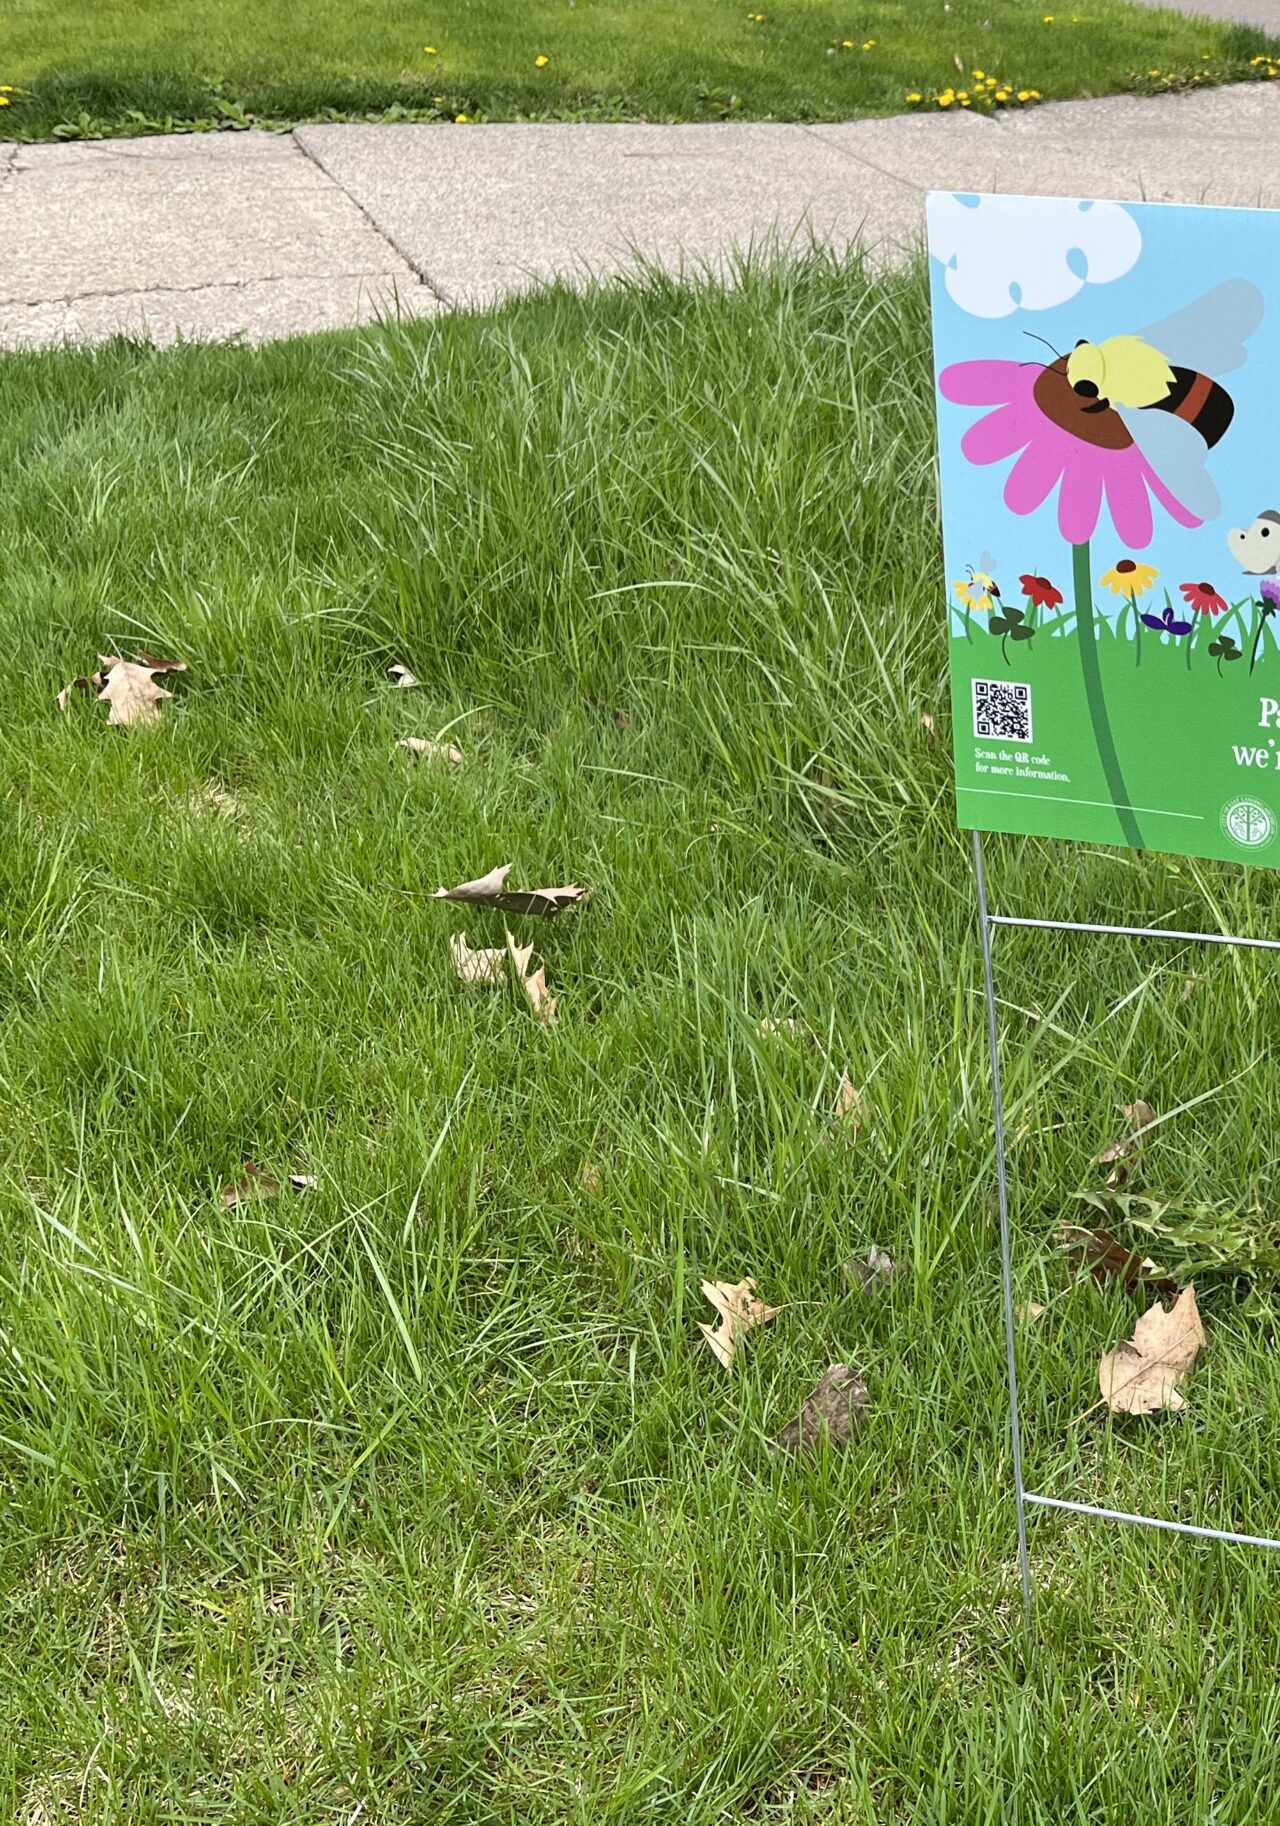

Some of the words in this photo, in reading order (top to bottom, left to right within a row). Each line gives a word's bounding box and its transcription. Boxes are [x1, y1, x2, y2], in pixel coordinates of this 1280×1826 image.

[974, 747, 997, 760] Scan
[999, 750, 1013, 762] the
[1015, 751, 1029, 764] QR
[1031, 754, 1051, 766] code
[975, 761, 989, 773] for
[991, 766, 1014, 776] more
[1015, 766, 1072, 783] information.
